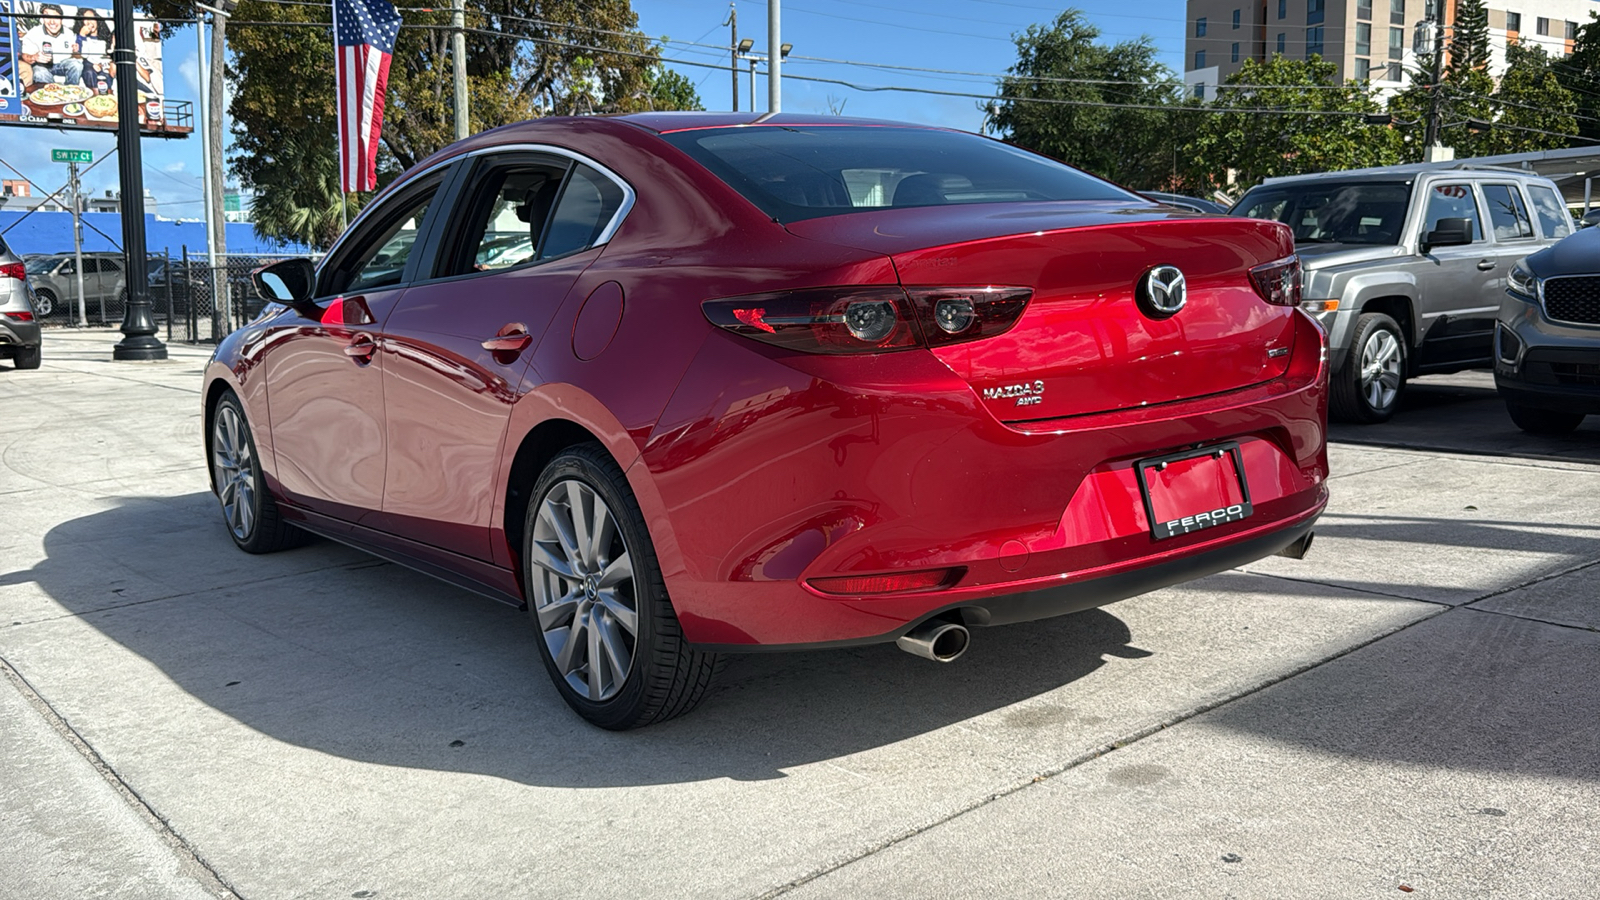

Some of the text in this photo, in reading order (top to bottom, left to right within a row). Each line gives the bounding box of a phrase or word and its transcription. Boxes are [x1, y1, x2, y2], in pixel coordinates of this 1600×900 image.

[56, 151, 90, 161] SW 17 Ct
[1016, 396, 1043, 406] AWD
[1166, 504, 1243, 531] FERCO
[1169, 512, 1244, 537] MOTORS
